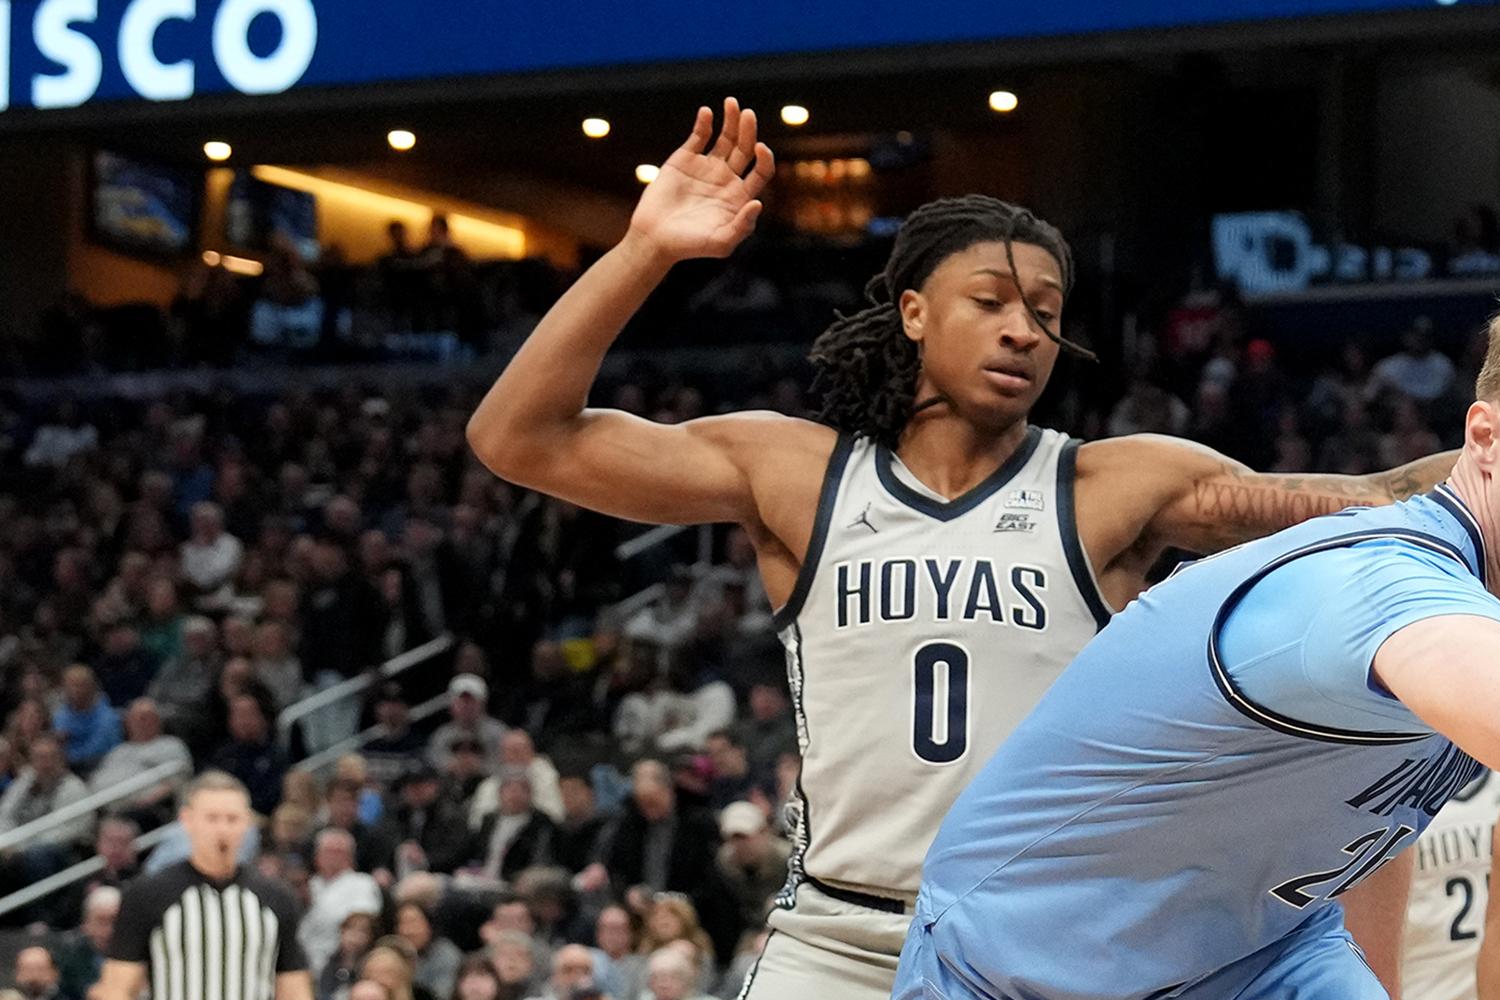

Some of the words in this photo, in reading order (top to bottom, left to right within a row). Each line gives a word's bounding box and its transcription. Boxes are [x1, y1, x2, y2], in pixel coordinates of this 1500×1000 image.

[995, 521, 1037, 530] EAST
[835, 556, 1049, 632] HOYAS
[910, 639, 970, 766] 0
